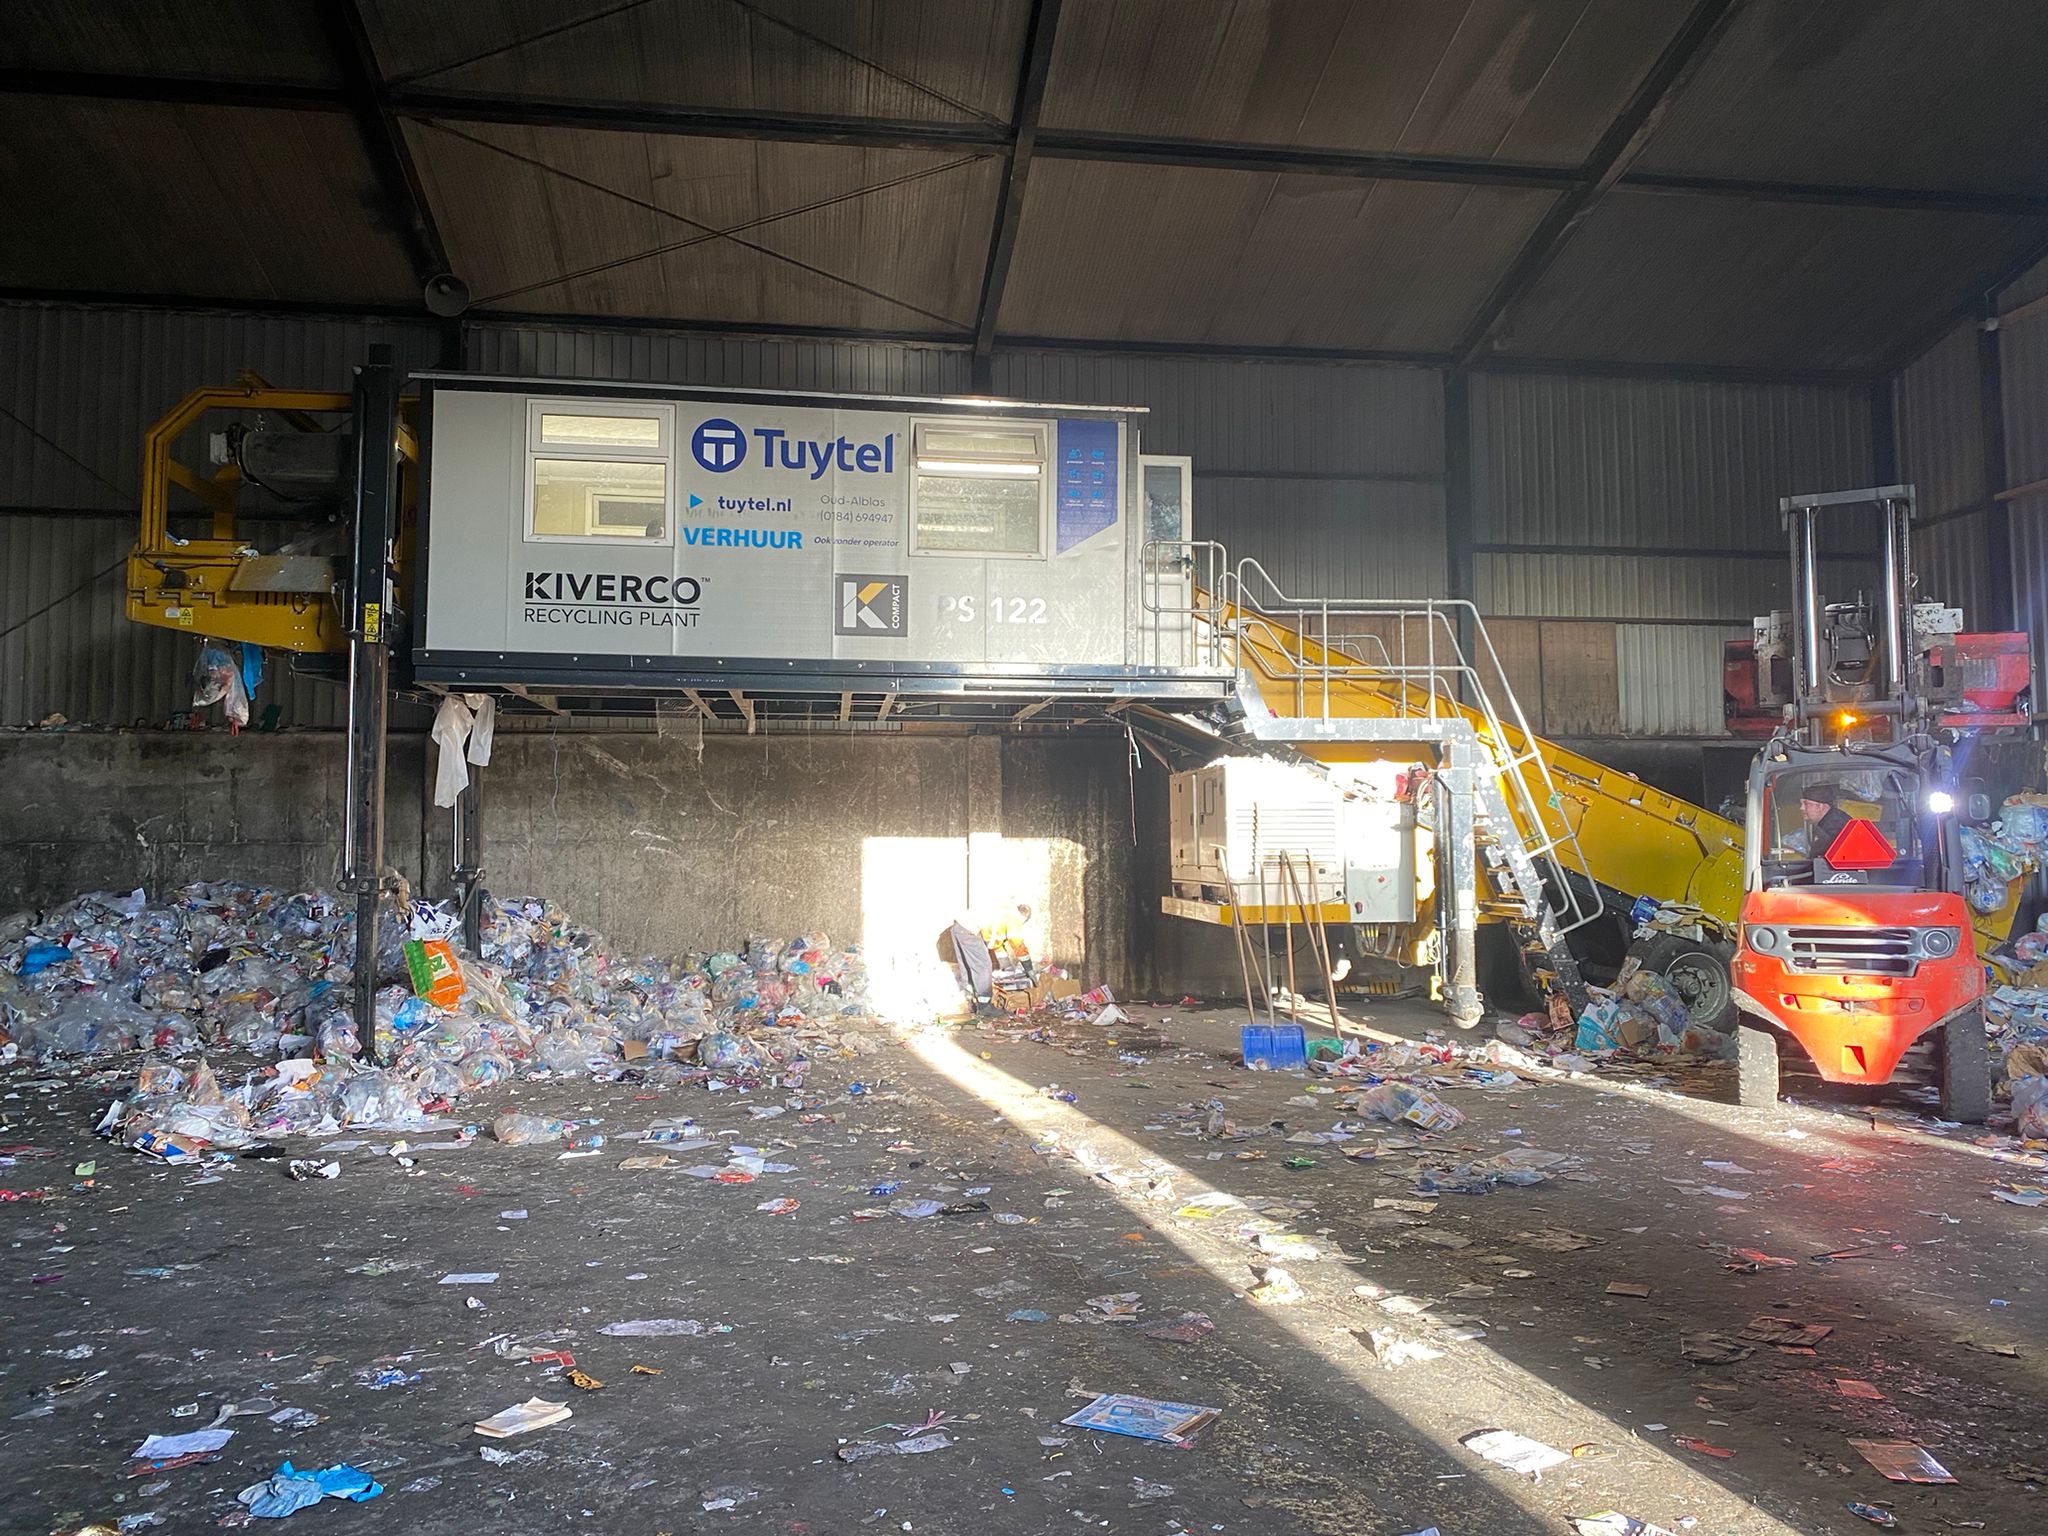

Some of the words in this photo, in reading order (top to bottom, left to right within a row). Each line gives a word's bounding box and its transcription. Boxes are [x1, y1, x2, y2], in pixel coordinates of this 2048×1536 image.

[753, 428, 894, 481] Tuytel
[718, 495, 792, 514] tuytel.nl
[820, 495, 886, 507] Oud-Alblas
[820, 511, 853, 524] (0184)
[855, 512, 894, 524] 694947
[683, 527, 803, 550] VERHUUR
[814, 536, 831, 545] Ook
[863, 538, 900, 548] operator
[525, 572, 701, 605] KIVERCO
[891, 584, 901, 629] COMPACT
[990, 596, 1049, 624] 122
[524, 608, 633, 627] RECYCLING
[640, 611, 701, 628] PLANT
